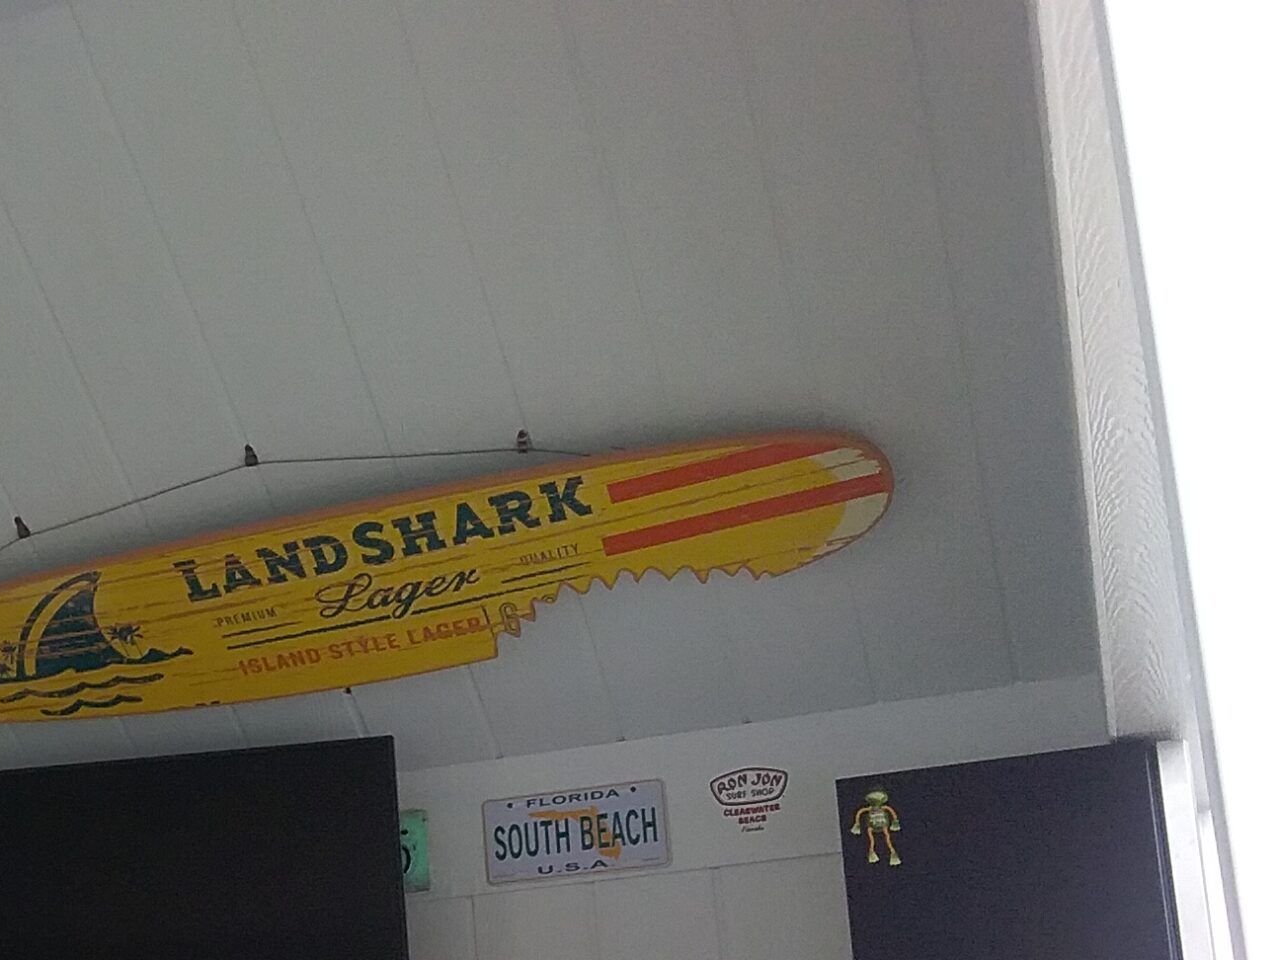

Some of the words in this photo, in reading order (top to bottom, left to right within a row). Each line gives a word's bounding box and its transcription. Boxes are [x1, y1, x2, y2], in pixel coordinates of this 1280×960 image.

[173, 475, 593, 602] LANDSHARK
[520, 543, 579, 565] QUALITY
[314, 568, 481, 620] Lager
[216, 607, 278, 627] PREMIUM
[239, 649, 321, 676] ISLAND
[328, 632, 401, 661] STYLE
[408, 616, 486, 646] LAGER
[717, 773, 747, 796] RON
[751, 773, 782, 787] JON
[750, 787, 774, 797] SHOP
[526, 788, 620, 808] FLORIDA
[723, 803, 780, 816] CLEARWATER
[494, 818, 570, 861] SOUTH
[580, 807, 658, 851] BEACH
